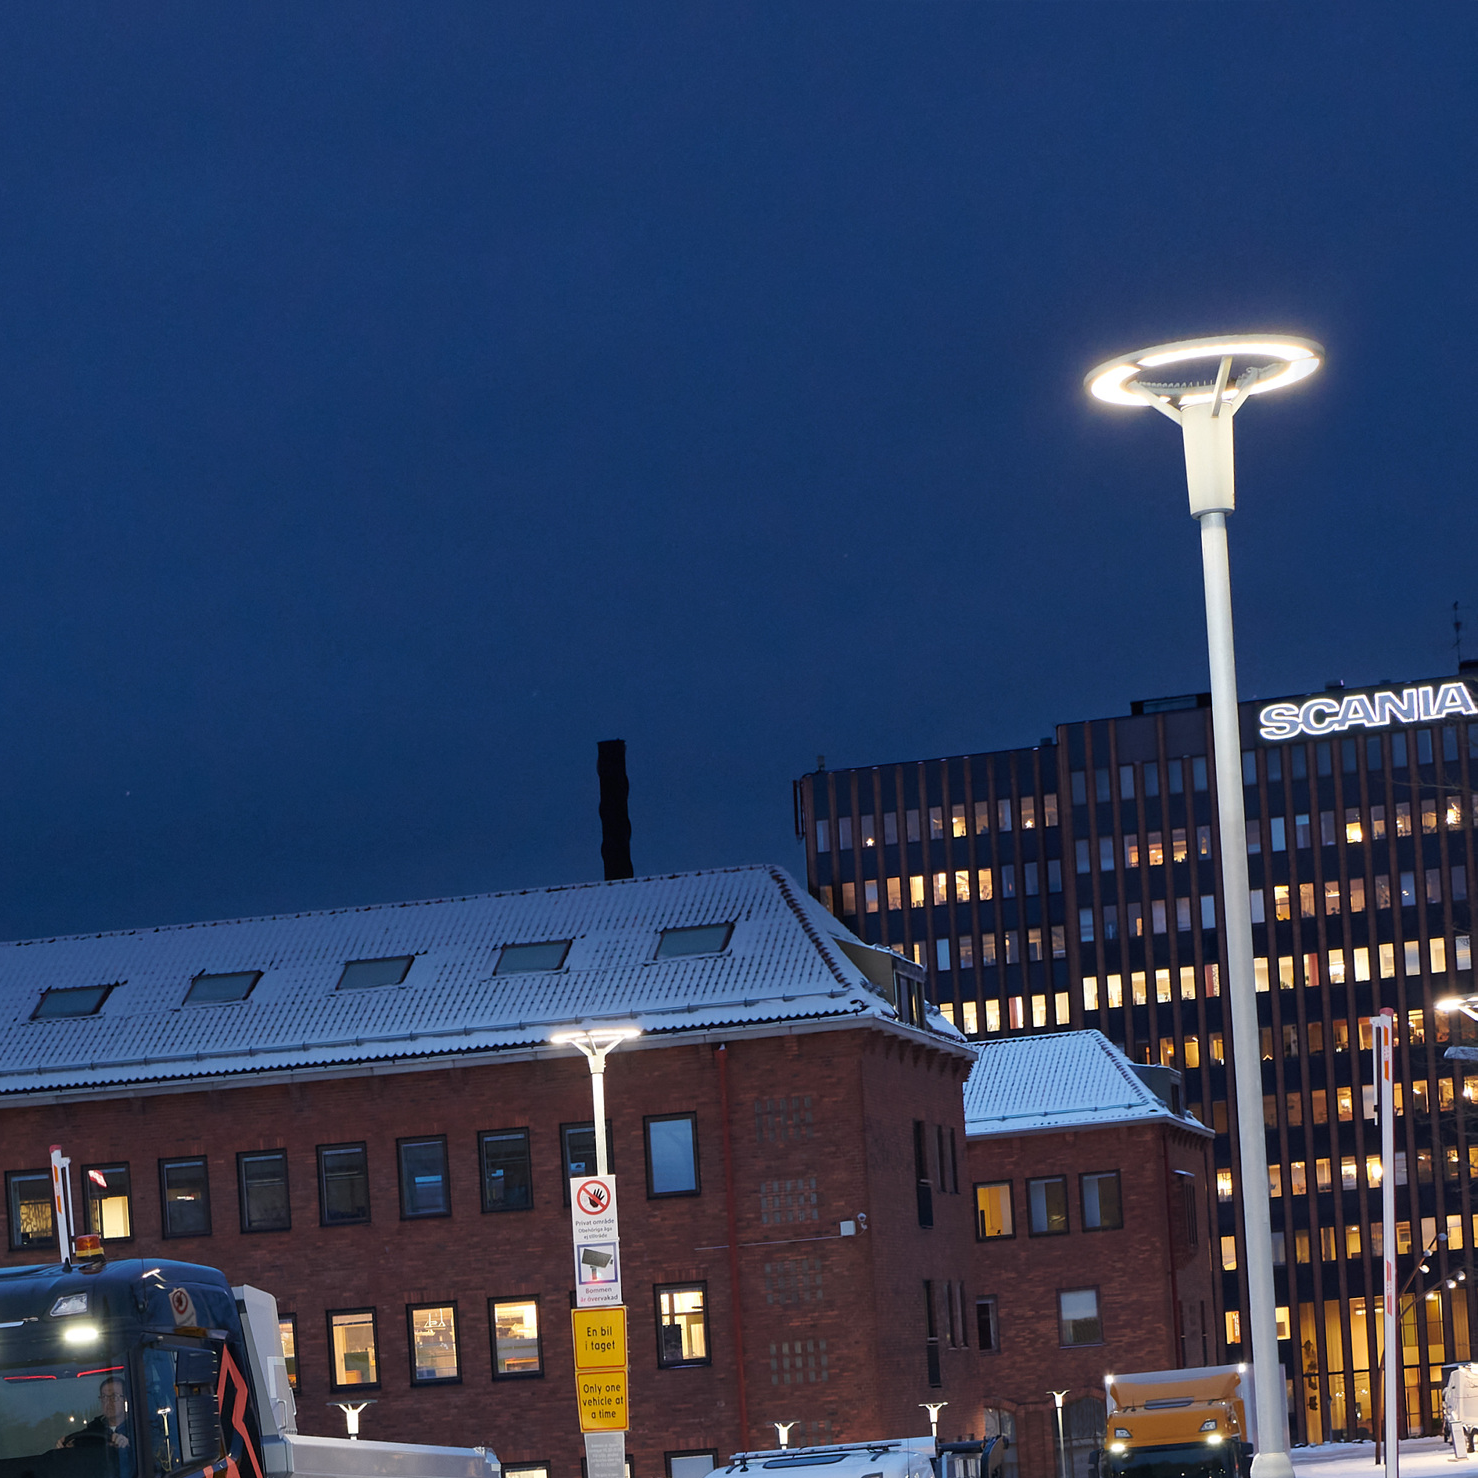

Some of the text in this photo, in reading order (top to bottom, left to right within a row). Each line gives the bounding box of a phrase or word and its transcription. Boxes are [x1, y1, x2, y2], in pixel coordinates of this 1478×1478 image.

[1259, 682, 1478, 740] SCANIA
[587, 1294, 619, 1302] övervakad
[587, 1325, 612, 1337] En bil
[591, 1340, 615, 1353] taget
[583, 1383, 621, 1395] Only one
[582, 1395, 624, 1406] vehicle at
[591, 1409, 616, 1419] a time
